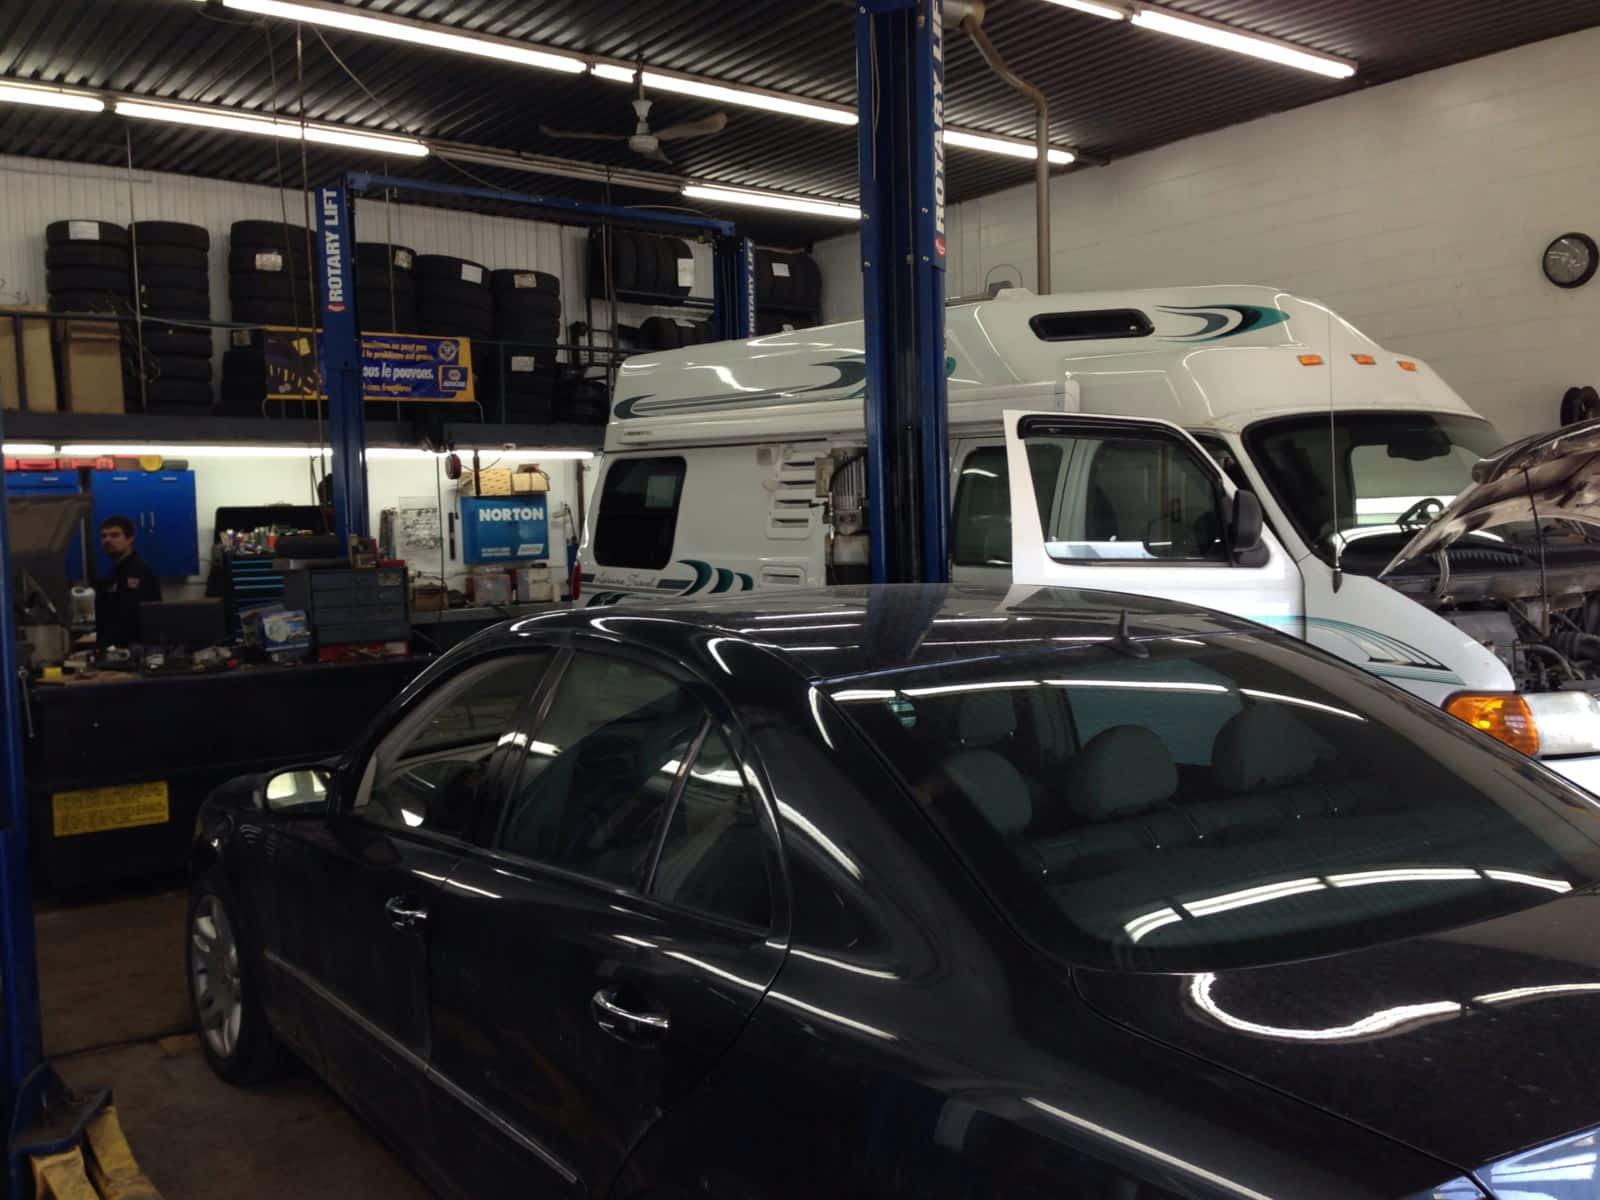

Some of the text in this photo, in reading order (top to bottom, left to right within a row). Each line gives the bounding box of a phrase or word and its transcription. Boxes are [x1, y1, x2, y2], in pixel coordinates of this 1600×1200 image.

[933, 0, 944, 234] ROTARY LIF
[323, 188, 343, 302] ROTARY LIFT
[362, 366, 380, 378] ous
[381, 362, 392, 378] le
[392, 367, 434, 382] pouvons.
[479, 507, 545, 522] NORTON
